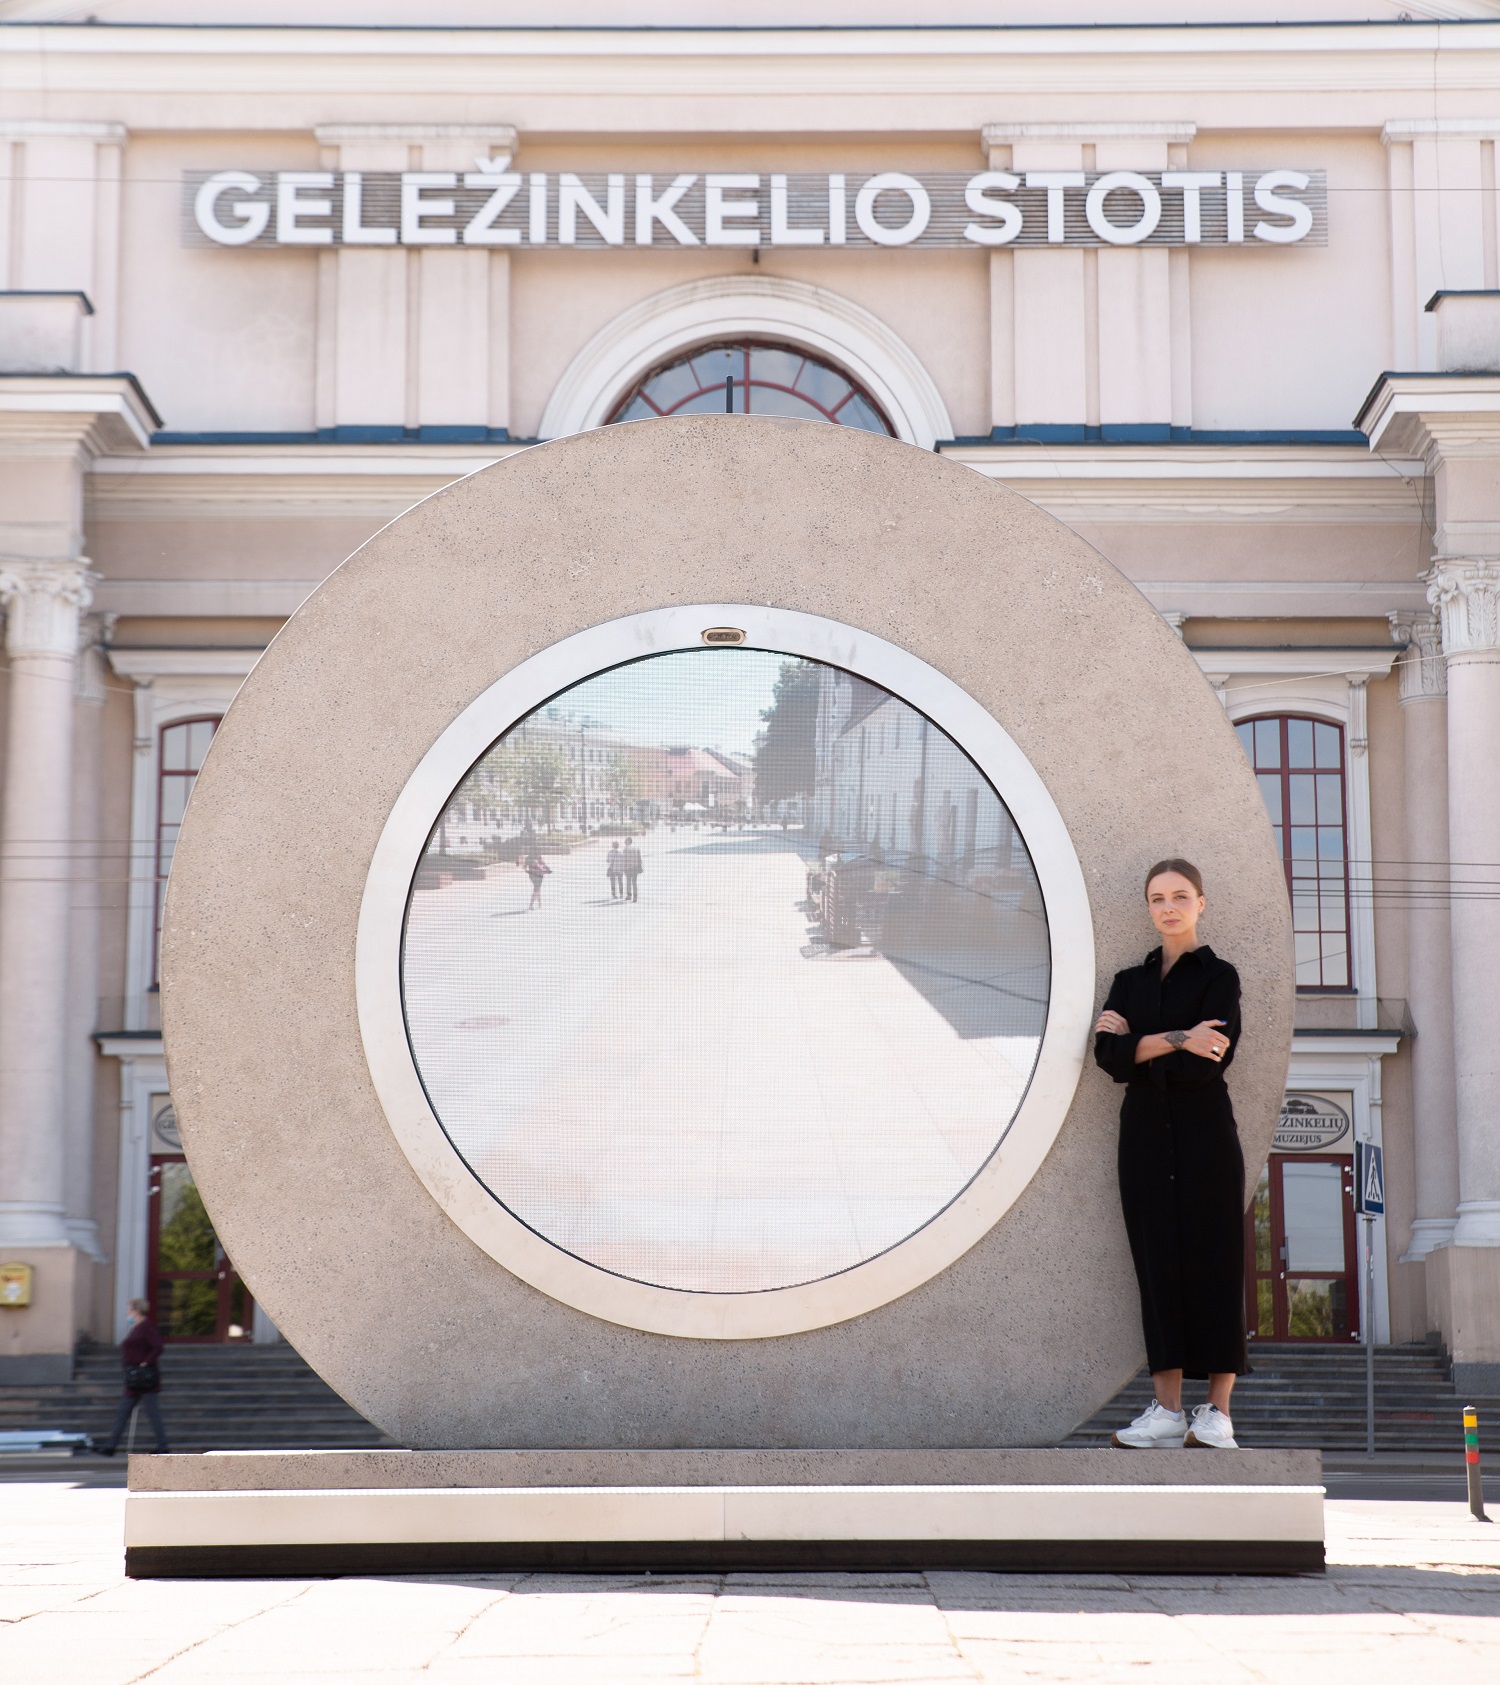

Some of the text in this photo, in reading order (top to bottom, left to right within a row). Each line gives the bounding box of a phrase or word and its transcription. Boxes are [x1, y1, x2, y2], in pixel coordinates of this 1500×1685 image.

[194, 155, 1313, 246] GELEŽINKELIO STOTIS
[1273, 1134, 1322, 1145] MUZIEJUS
